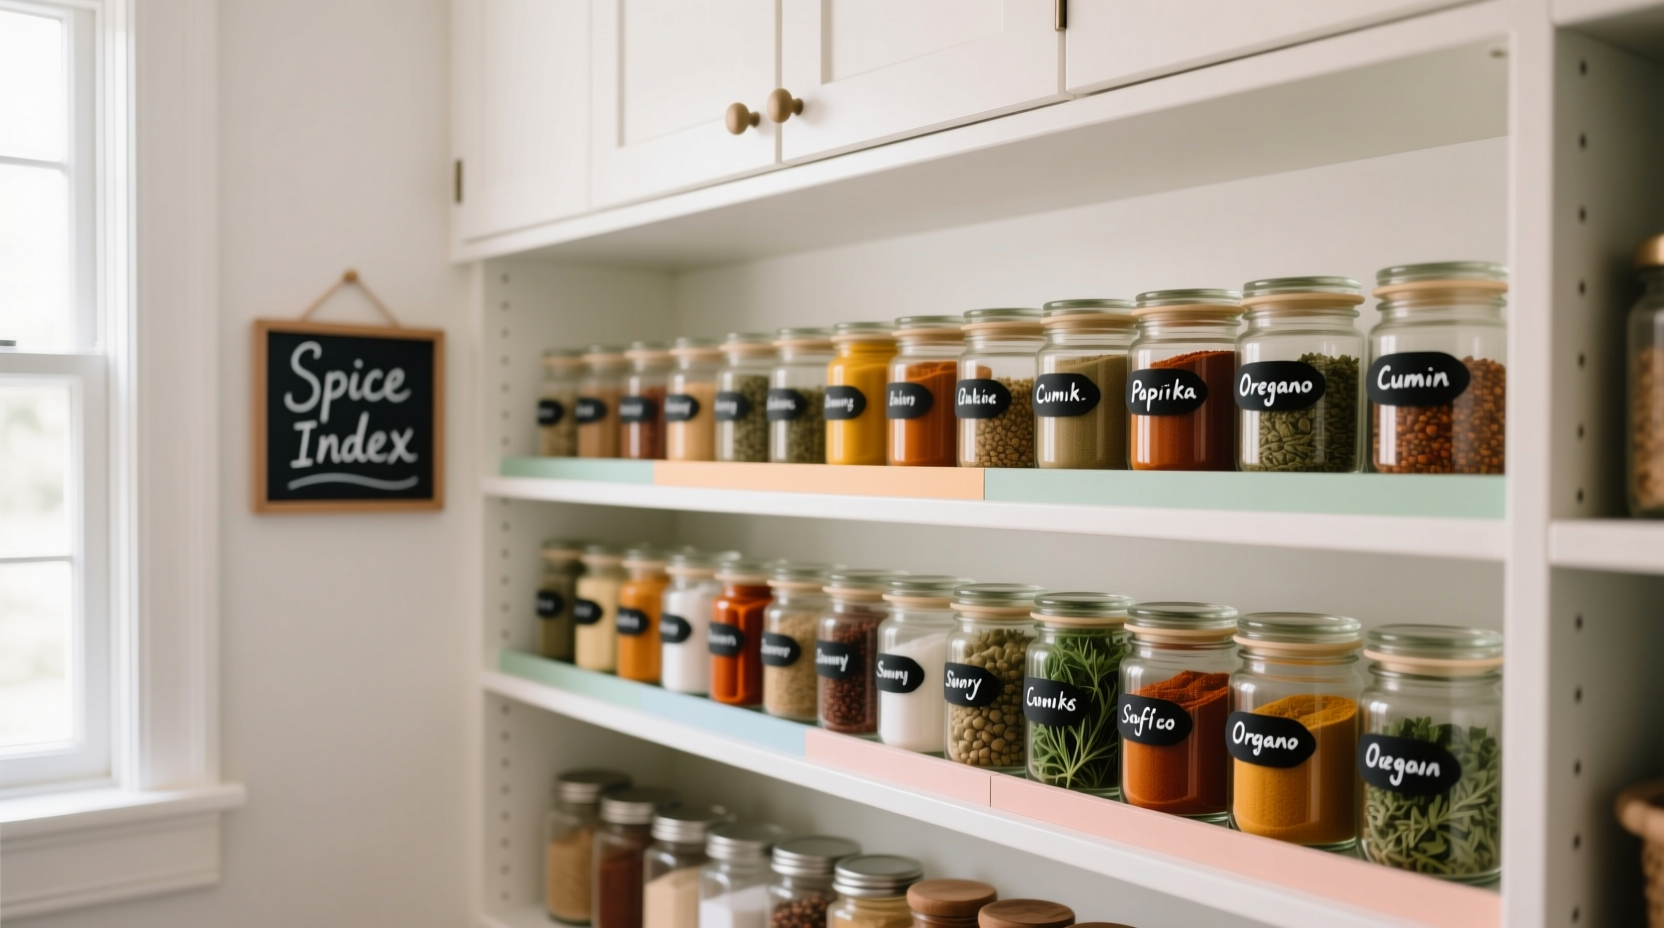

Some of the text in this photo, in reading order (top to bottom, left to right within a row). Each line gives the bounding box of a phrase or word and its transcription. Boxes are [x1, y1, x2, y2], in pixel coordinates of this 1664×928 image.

[284, 340, 412, 424] Spice
[1239, 373, 1313, 406] Oregano
[1377, 365, 1450, 390] Cumin
[289, 411, 419, 469] Index
[1232, 720, 1299, 756] Organo
